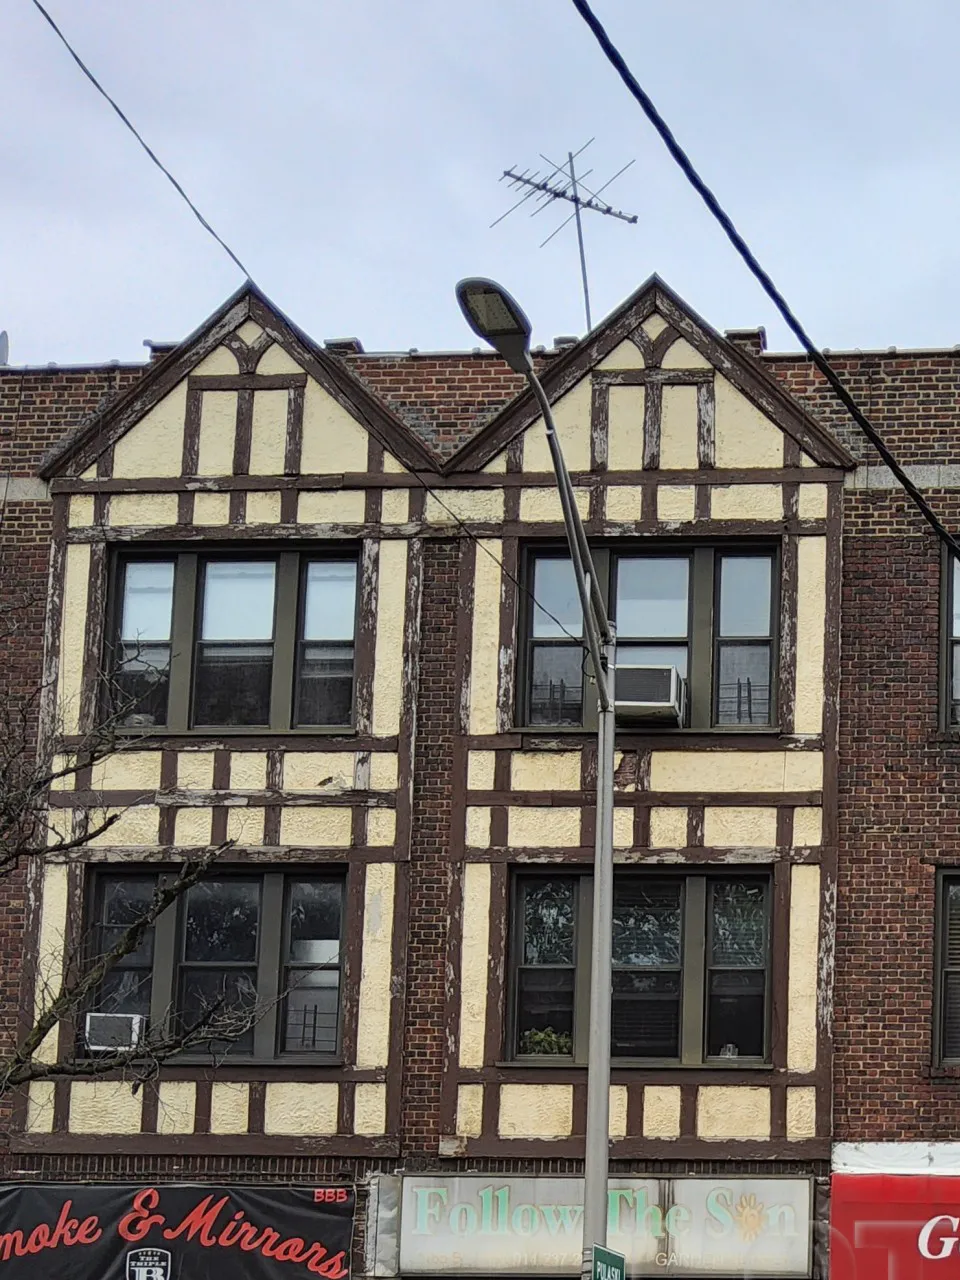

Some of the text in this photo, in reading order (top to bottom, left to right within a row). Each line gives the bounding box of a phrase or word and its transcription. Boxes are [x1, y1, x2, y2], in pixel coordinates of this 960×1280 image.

[313, 1188, 348, 1203] BBB
[413, 1184, 586, 1238] Follow
[607, 1188, 690, 1238] The
[118, 1188, 166, 1241] &
[164, 1195, 350, 1280] Mirrors
